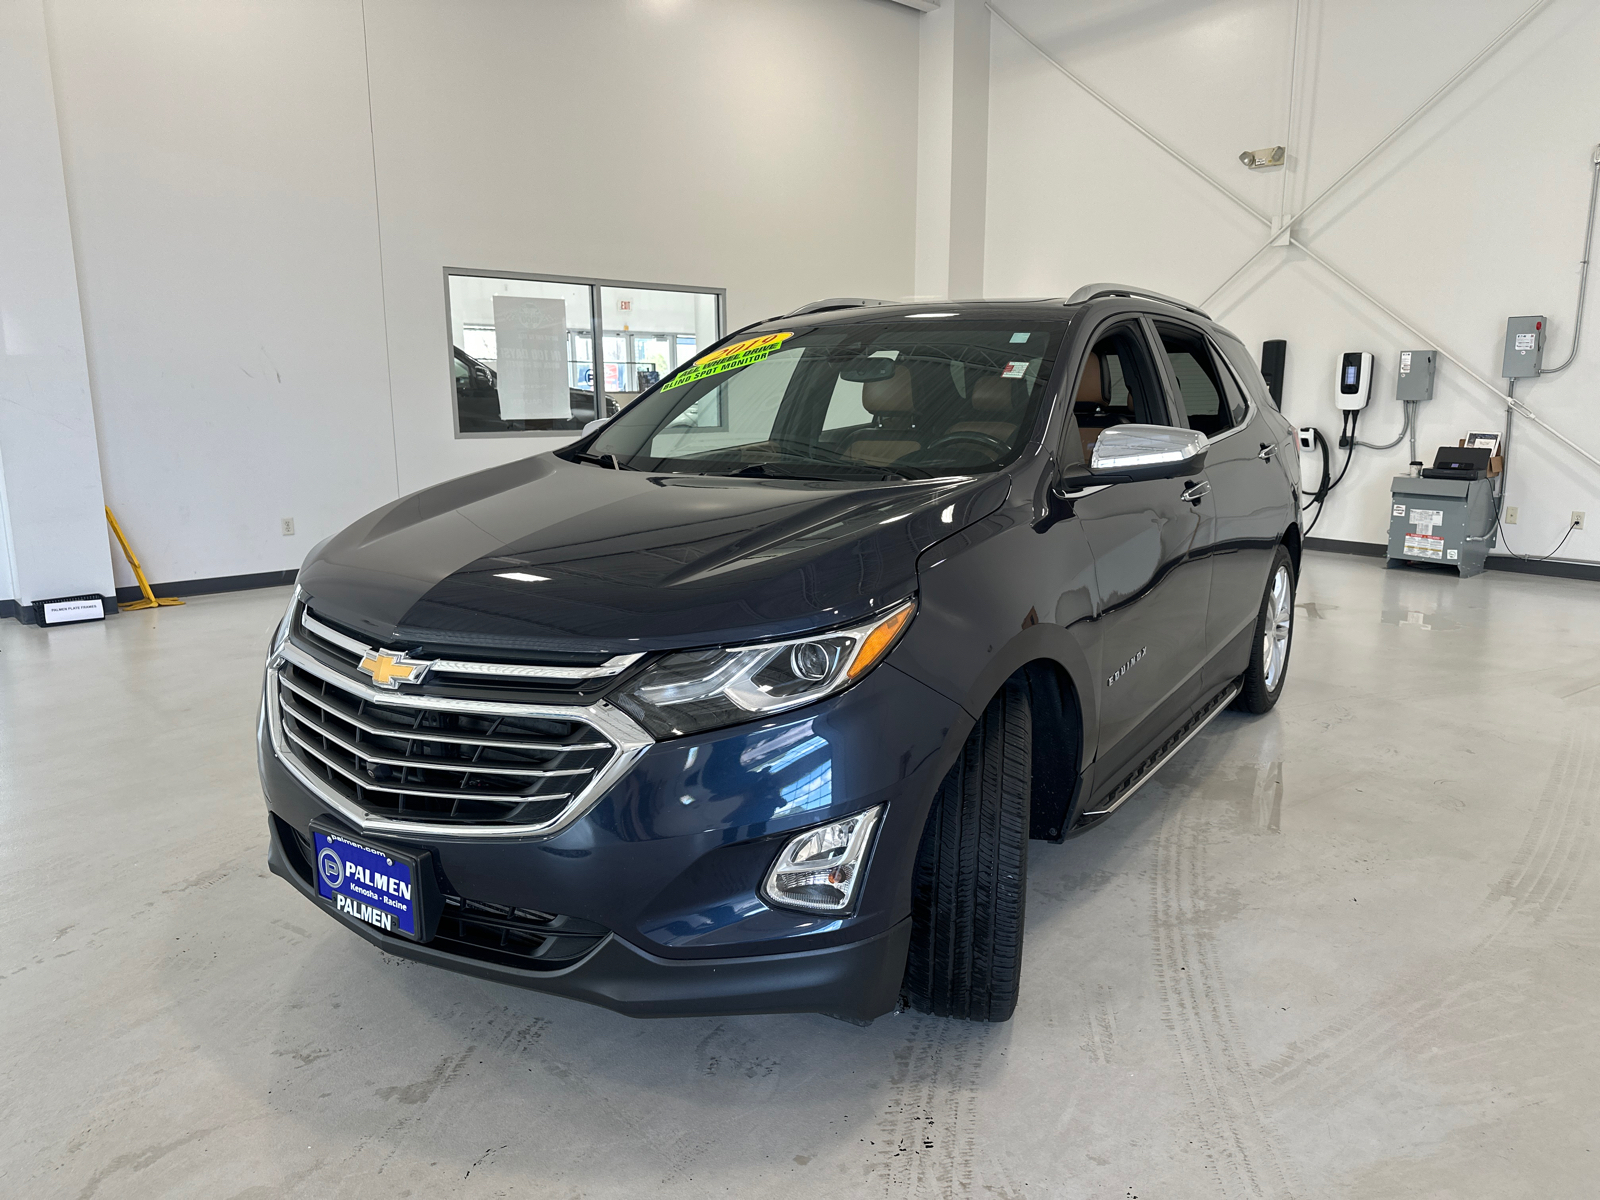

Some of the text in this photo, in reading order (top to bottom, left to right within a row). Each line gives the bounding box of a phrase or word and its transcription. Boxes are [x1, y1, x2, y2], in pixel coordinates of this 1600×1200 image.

[663, 352, 768, 391] BLIND SPOT MONITOR
[679, 341, 780, 379] ALL WHEEL DRIVE
[1107, 646, 1147, 687] EQUINOX
[331, 834, 386, 858] palmen.com
[345, 861, 411, 900] PALMEN
[350, 882, 378, 900] Kenosha
[383, 895, 407, 911] Racine
[336, 894, 391, 931] PALMEN
